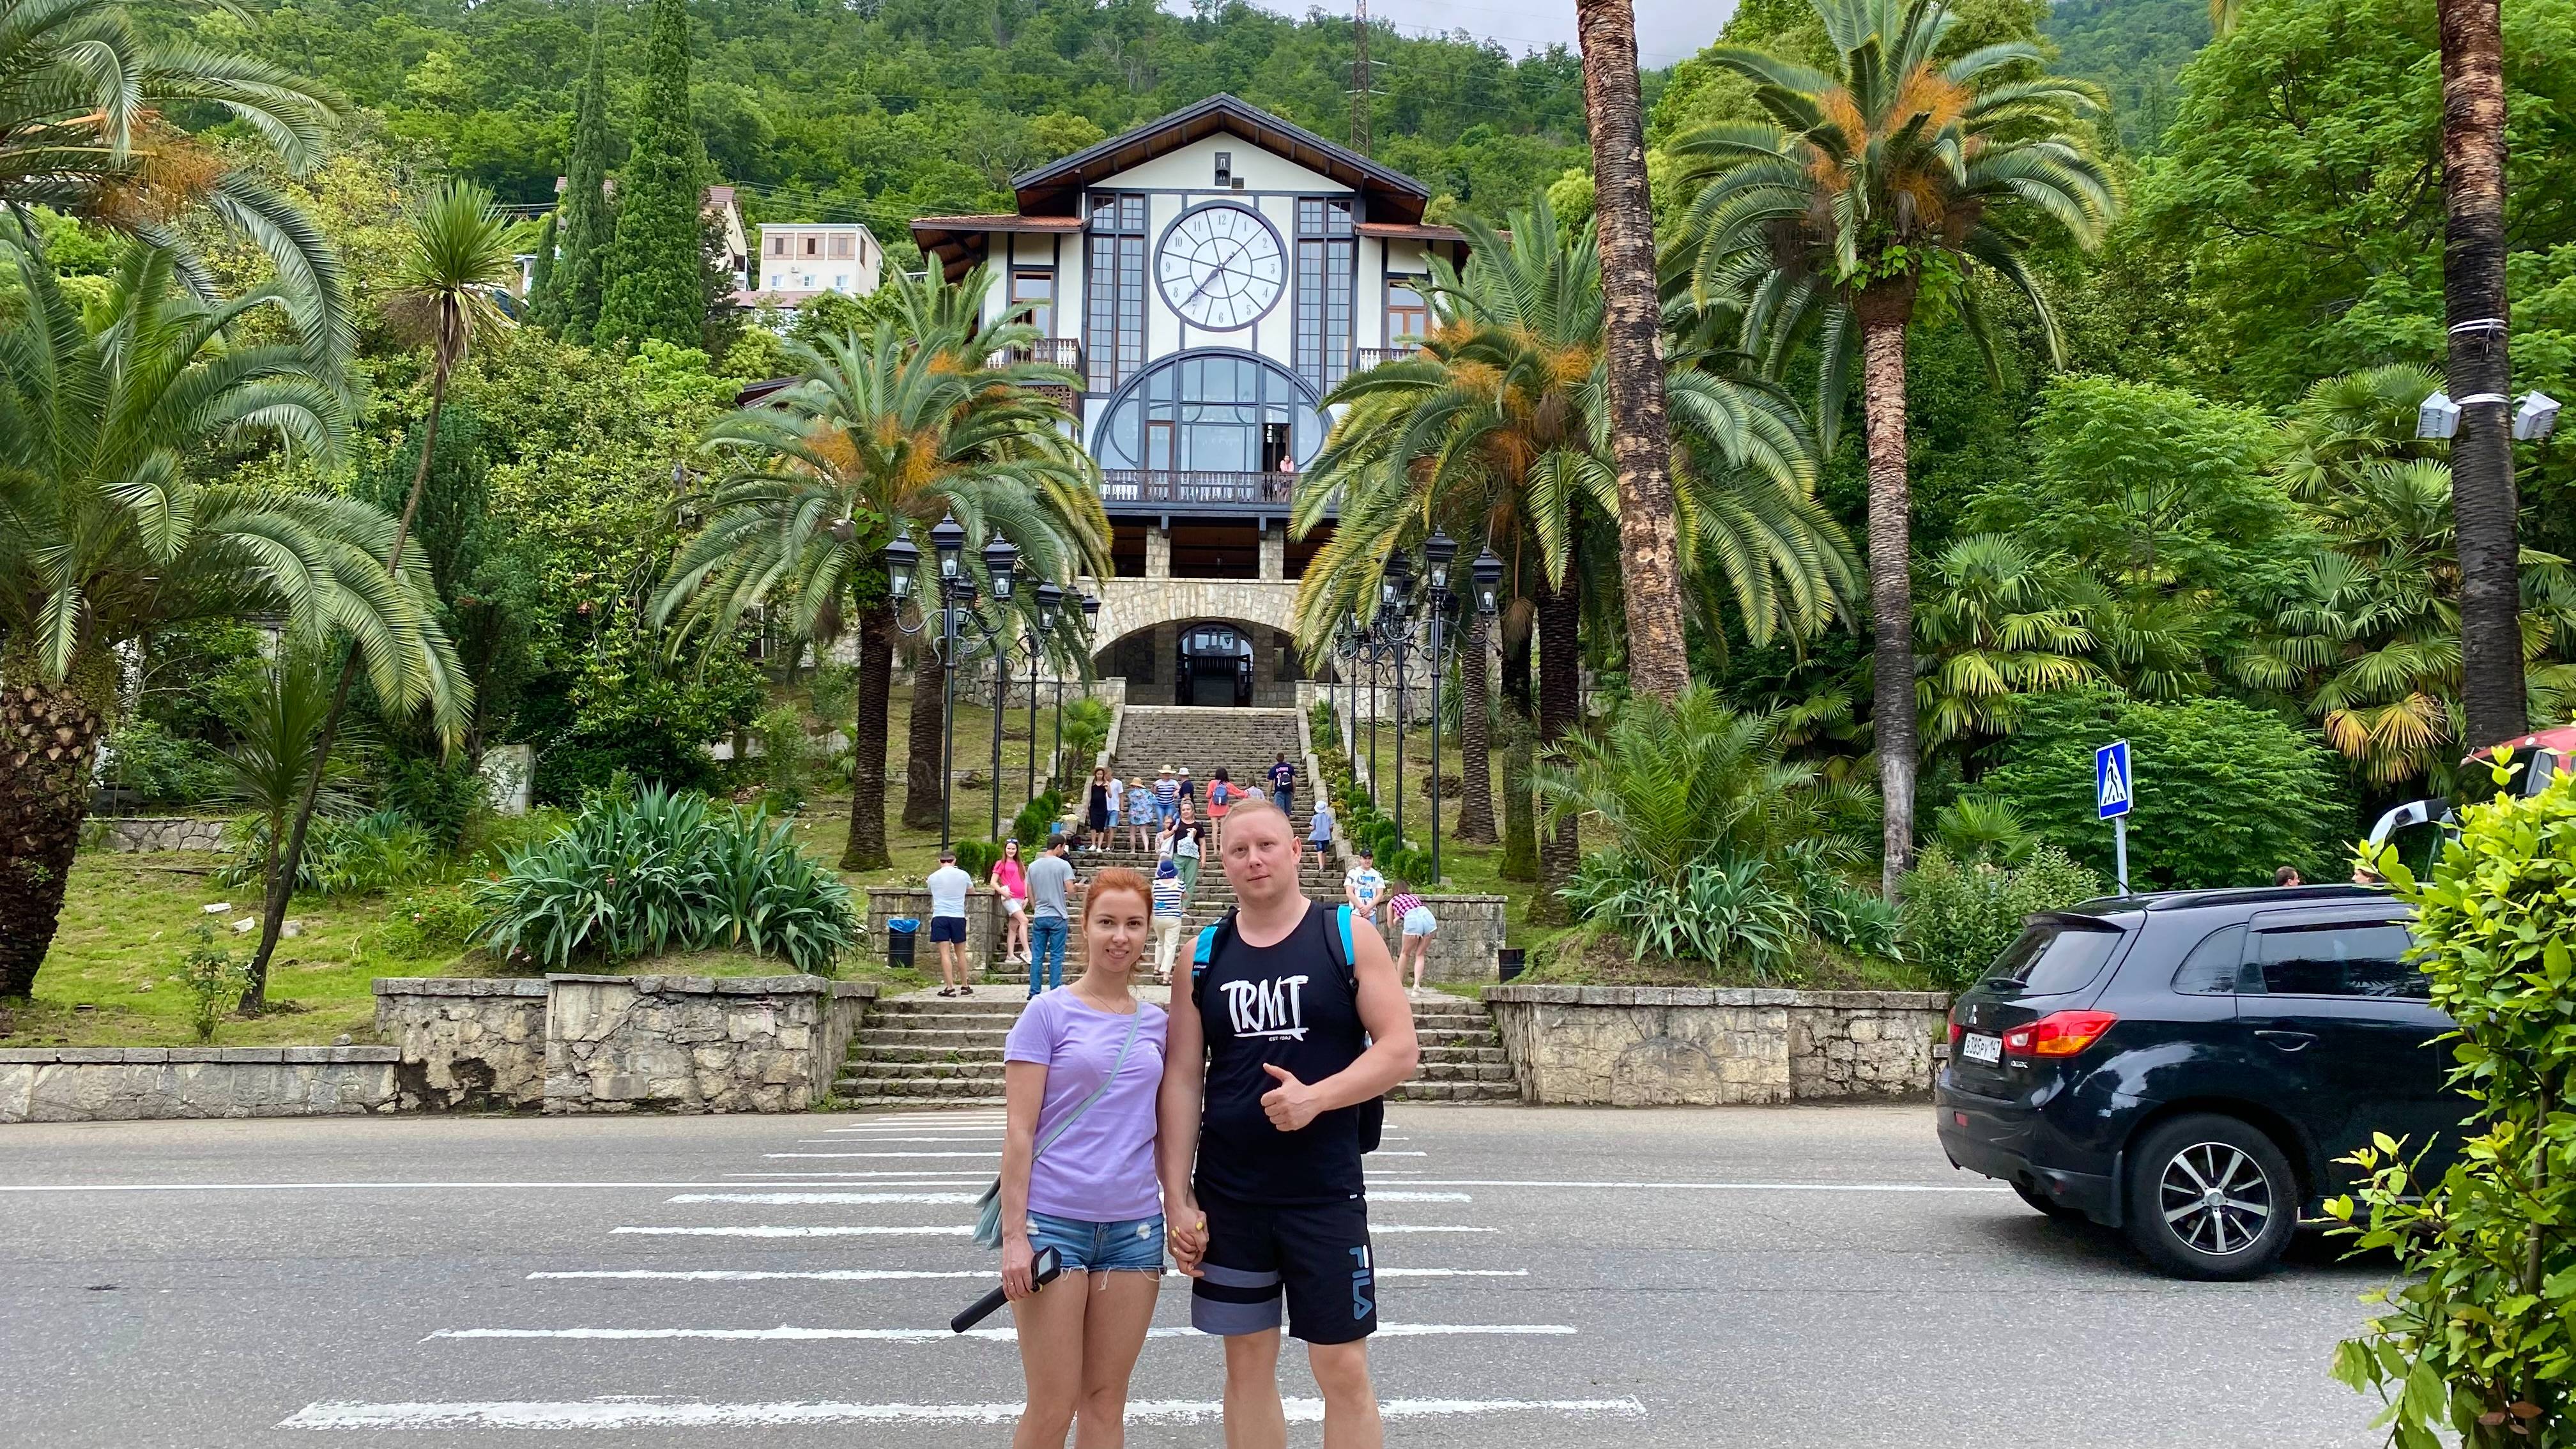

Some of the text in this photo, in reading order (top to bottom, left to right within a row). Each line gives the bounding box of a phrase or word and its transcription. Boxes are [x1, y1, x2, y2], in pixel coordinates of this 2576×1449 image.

[1193, 220, 1201, 232] 11
[1218, 214, 1227, 226] 12
[1243, 220, 1247, 232] 1
[1175, 236, 1183, 248] 10
[1262, 238, 1268, 249] 2
[1165, 261, 1171, 272] 9
[1270, 263, 1275, 275] 3
[1173, 288, 1179, 298] 8
[1262, 287, 1268, 298] 4
[1192, 304, 1197, 315] 7
[1246, 304, 1252, 316] 5
[1218, 312, 1223, 323] 6
[1220, 975, 1309, 1032] TRMT
[1349, 1245, 1373, 1320] FILA
